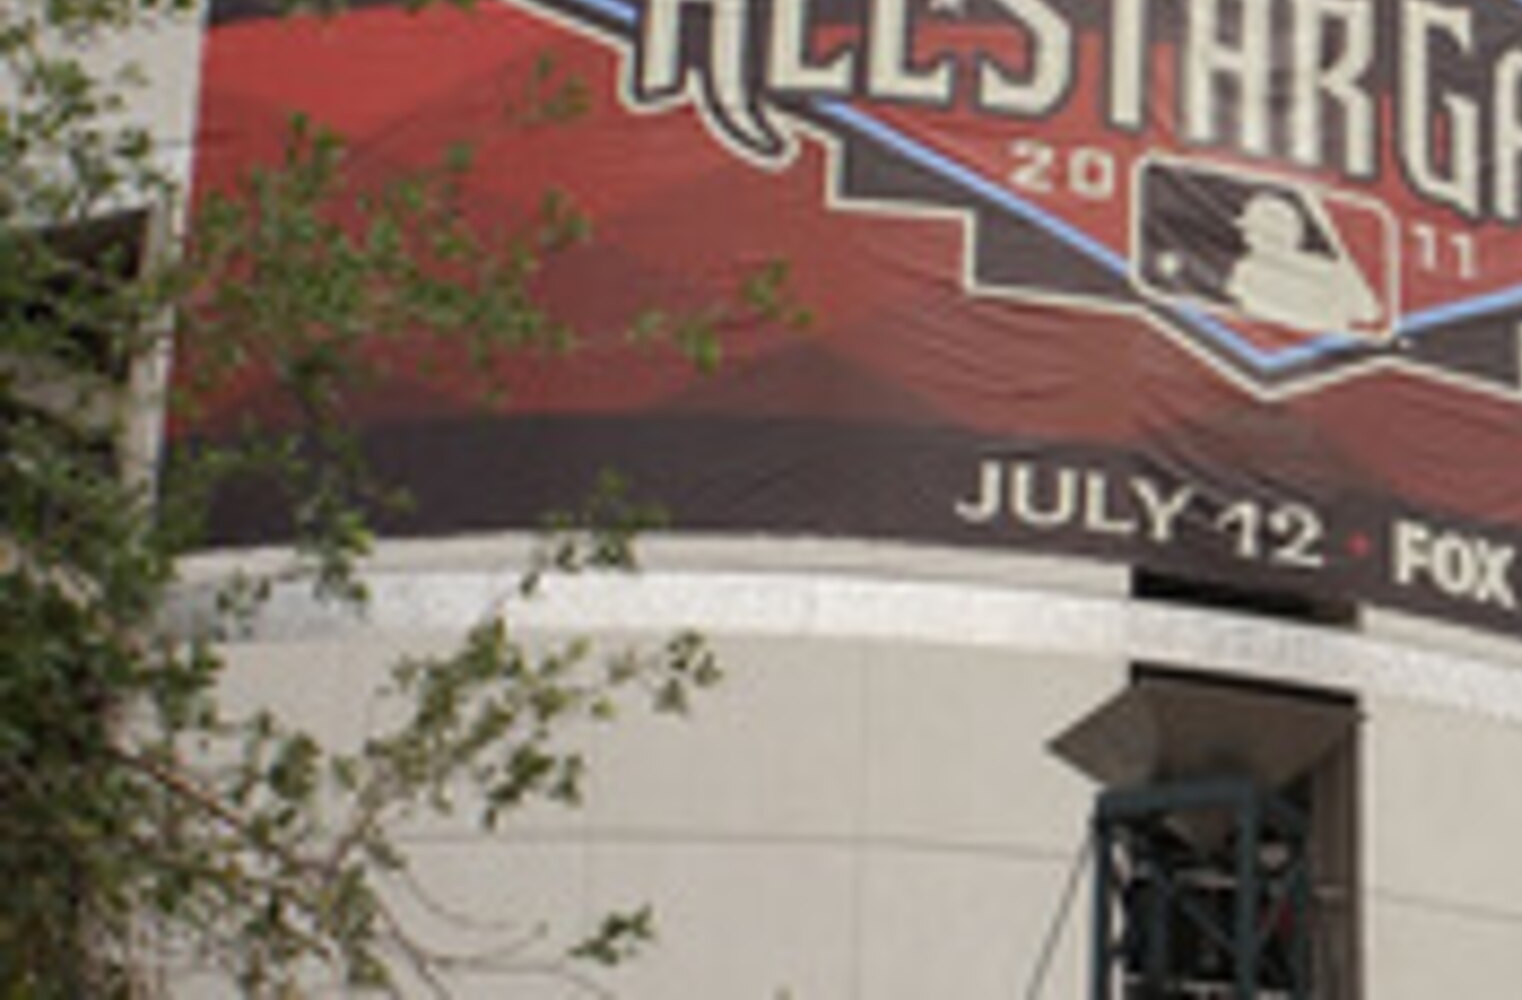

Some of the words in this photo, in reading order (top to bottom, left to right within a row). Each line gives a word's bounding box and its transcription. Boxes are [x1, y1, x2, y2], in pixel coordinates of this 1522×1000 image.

[1007, 140, 1116, 199] 20
[1411, 223, 1478, 281] 11
[954, 459, 1195, 543] JULY
[1215, 501, 1325, 568] 12
[1391, 519, 1518, 610] FOX
